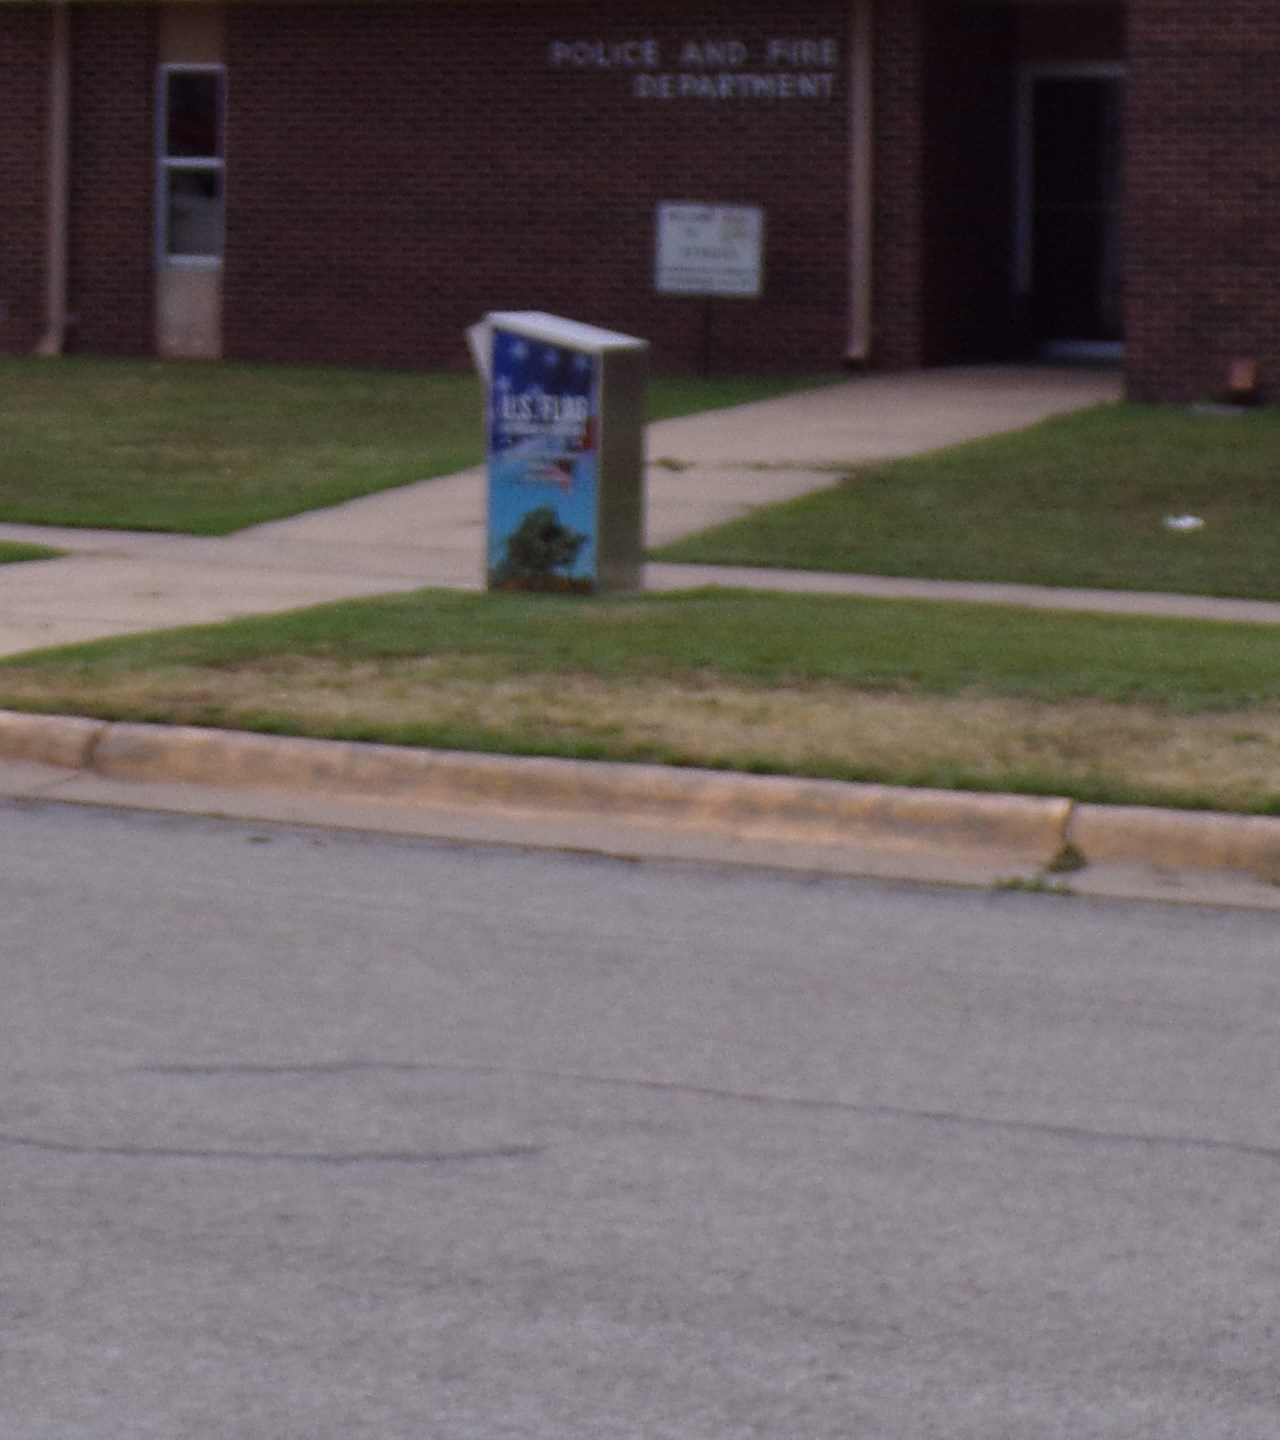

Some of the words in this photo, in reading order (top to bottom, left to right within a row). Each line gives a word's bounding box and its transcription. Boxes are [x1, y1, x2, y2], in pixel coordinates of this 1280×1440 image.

[549, 40, 659, 66] POLICE
[679, 40, 748, 65] AND
[767, 38, 838, 65] FIRE
[634, 73, 835, 99] DEPARTMENT
